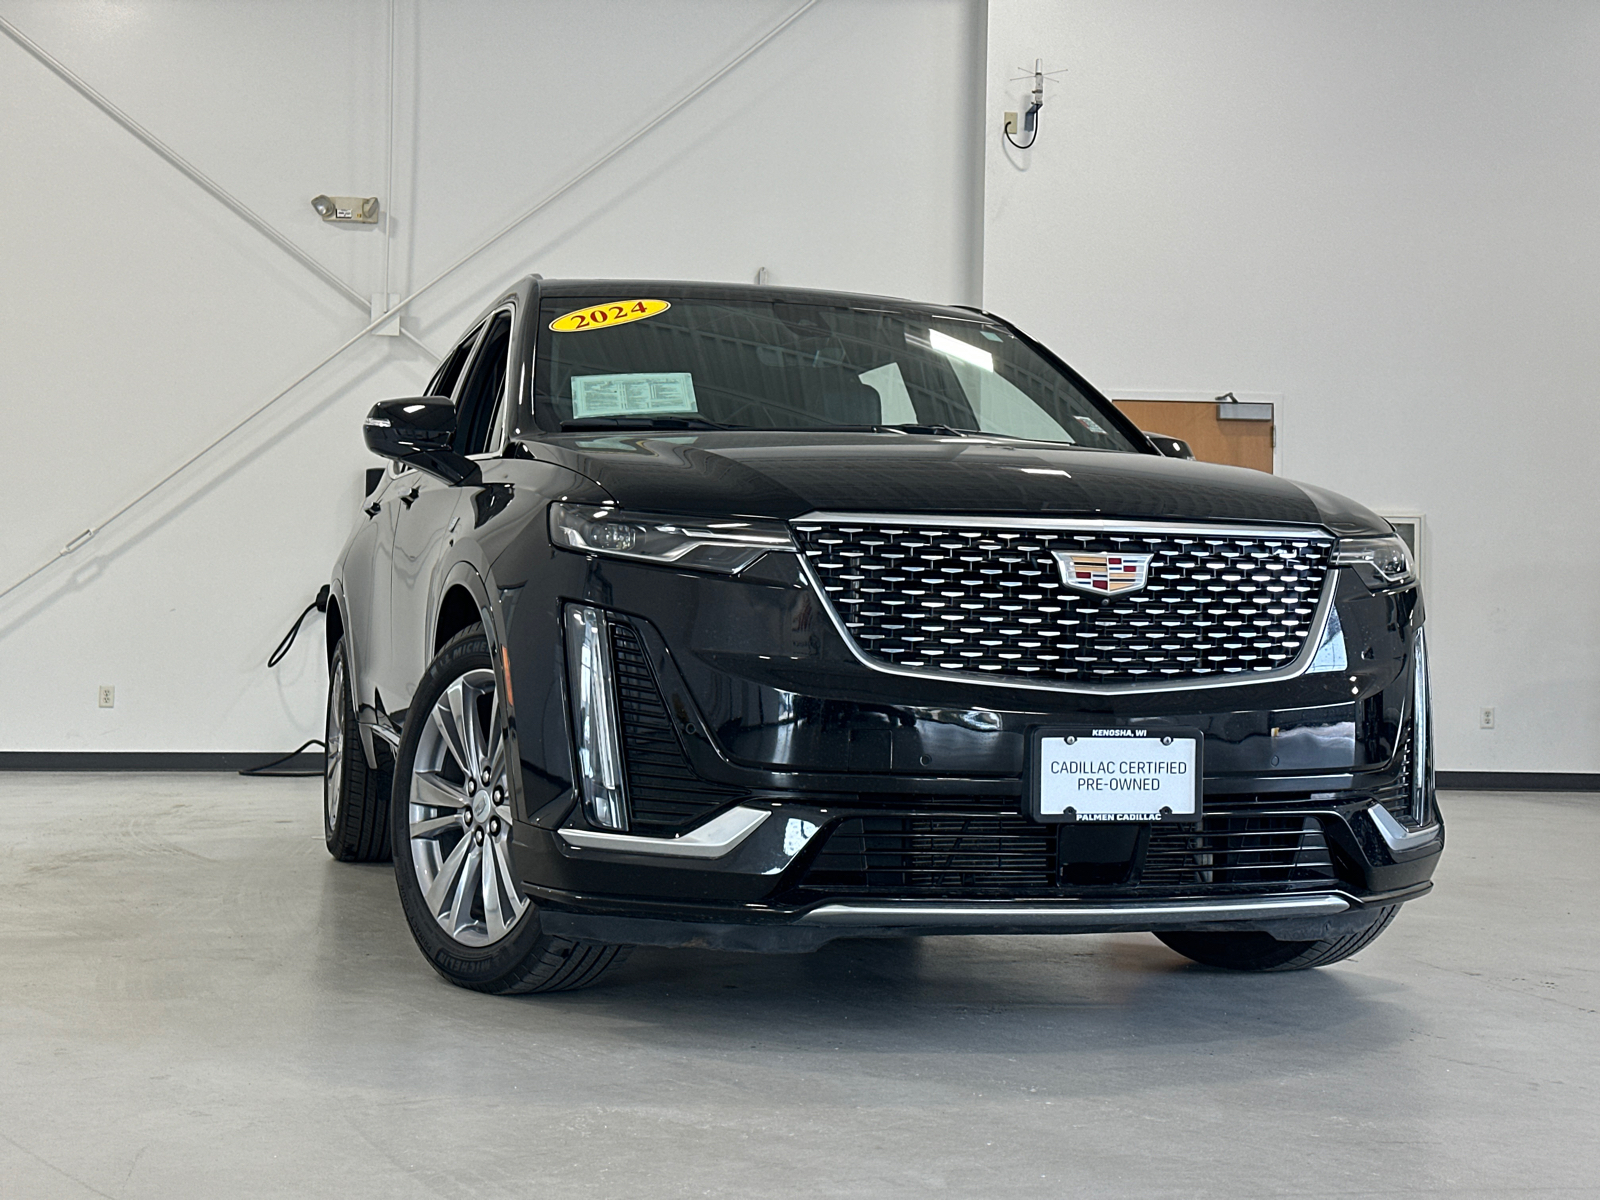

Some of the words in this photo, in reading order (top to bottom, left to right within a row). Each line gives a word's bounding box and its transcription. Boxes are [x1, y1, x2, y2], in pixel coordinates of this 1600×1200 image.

[570, 301, 647, 329] 2024
[453, 641, 489, 660] MICHE
[1092, 729, 1134, 738] KENOSHA,
[1135, 729, 1147, 737] WI
[1050, 761, 1116, 775] CADILLAC
[1119, 761, 1187, 775] CERTIFIED
[1077, 778, 1160, 791] PRE-OWNED
[1076, 813, 1115, 821] PALMEN
[1116, 813, 1162, 821] CADILLAC
[400, 884, 410, 912] TOUR
[410, 915, 432, 952] PRIMACY
[437, 952, 491, 973] MICHELIN
